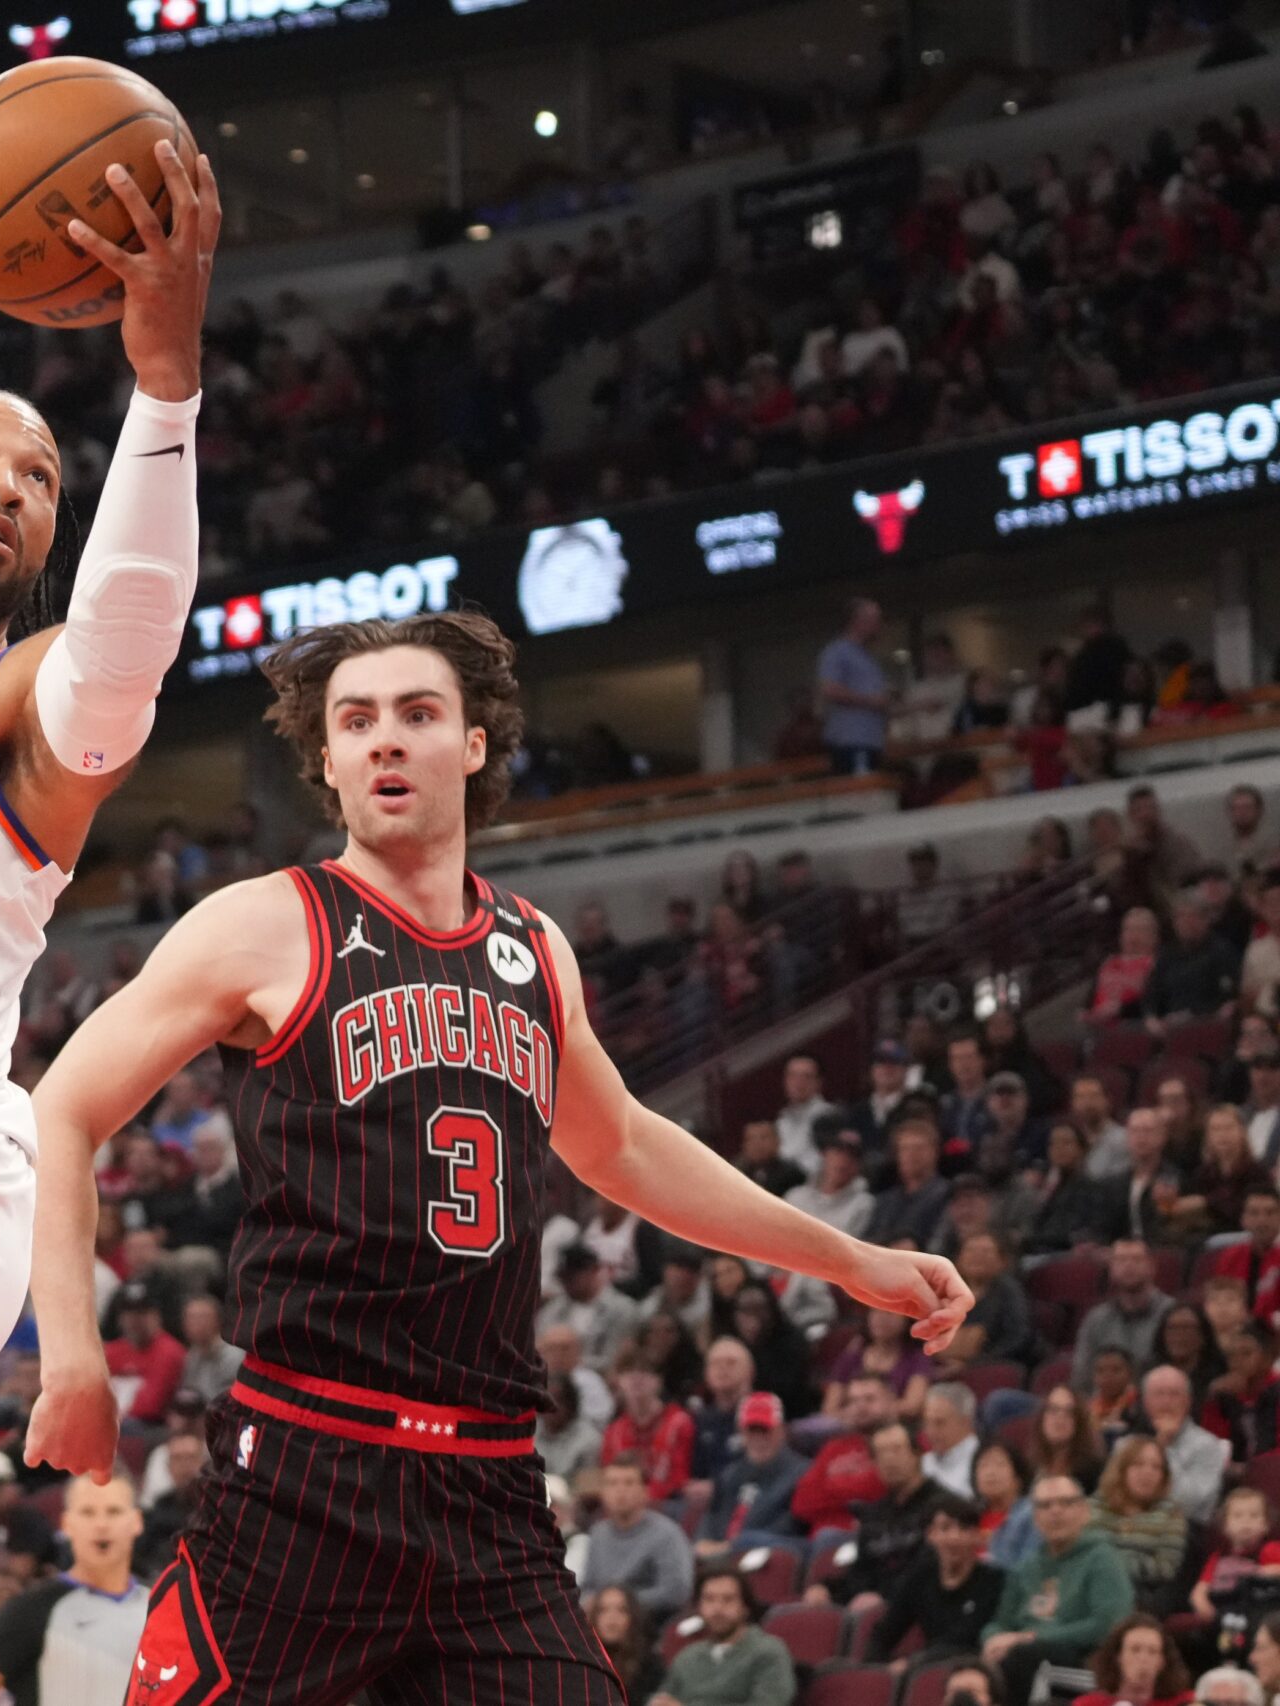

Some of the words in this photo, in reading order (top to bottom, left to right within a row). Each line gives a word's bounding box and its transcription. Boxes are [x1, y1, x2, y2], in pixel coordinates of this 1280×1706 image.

[1081, 400, 1280, 488] TISSO
[261, 555, 459, 641] TISSOT
[331, 983, 552, 1128] CHICAGO
[426, 1105, 505, 1258] 3
